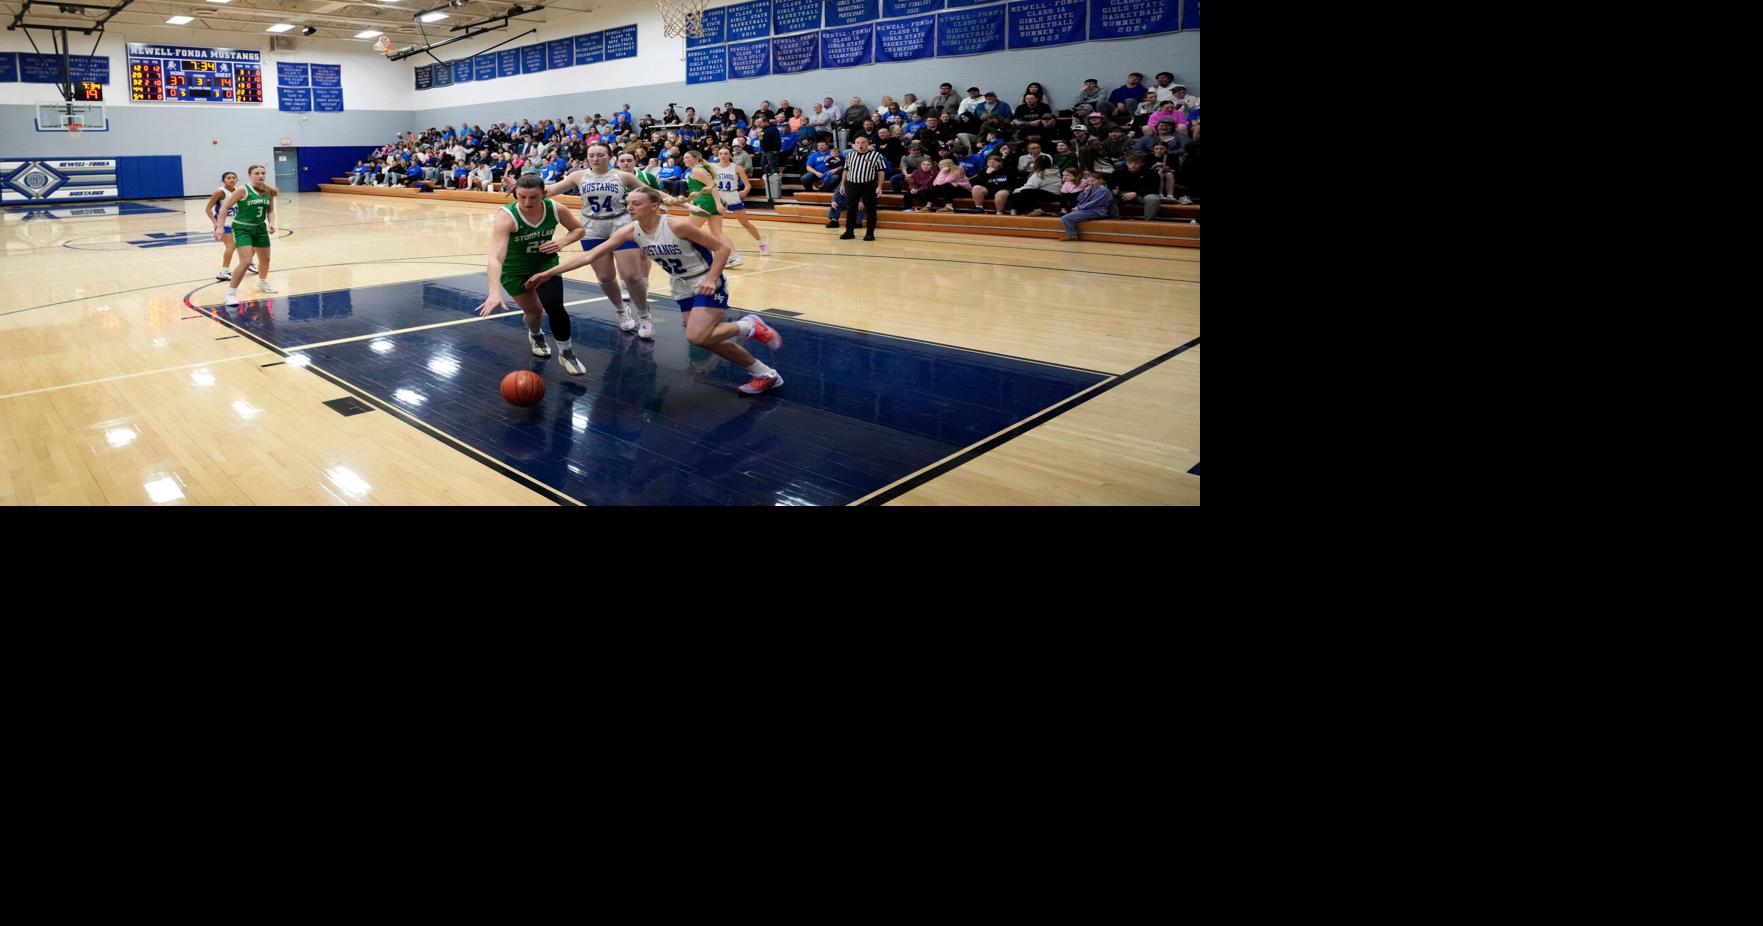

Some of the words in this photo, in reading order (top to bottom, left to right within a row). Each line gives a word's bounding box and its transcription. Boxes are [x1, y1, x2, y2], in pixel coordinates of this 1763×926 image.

[838, 3, 864, 12] BASKETBALL
[1102, 5, 1129, 14] GIRLS
[1133, 0, 1165, 10] STATE
[778, 10, 818, 20] BASKETBALL
[1047, 12, 1074, 20] STATE
[1102, 7, 1164, 20] BASKETBALL
[731, 18, 768, 28] BASKETBALL
[1019, 19, 1074, 30] BASKETBALL
[947, 30, 994, 40] BASKETBALL
[1032, 34, 1059, 42] 2023
[883, 38, 924, 46] BASKETBALL
[828, 46, 864, 54] BASKETBALL
[885, 44, 923, 52] CHAMPIONS
[210, 50, 260, 60] MUSTANGS
[778, 52, 812, 61] BASKETBALL
[830, 51, 862, 60] CHAMPIONS
[190, 61, 214, 70] 7:34
[733, 58, 764, 66] BASKETBALL
[170, 76, 184, 86] 37
[197, 78, 202, 86] 3
[222, 78, 231, 86] 14
[170, 88, 176, 96] 0
[582, 182, 618, 194] MUSTANGS
[588, 196, 613, 213] 54
[256, 206, 263, 218] 3
[514, 231, 540, 242] STORM
[655, 258, 687, 274] 32
[714, 293, 724, 304] NF
